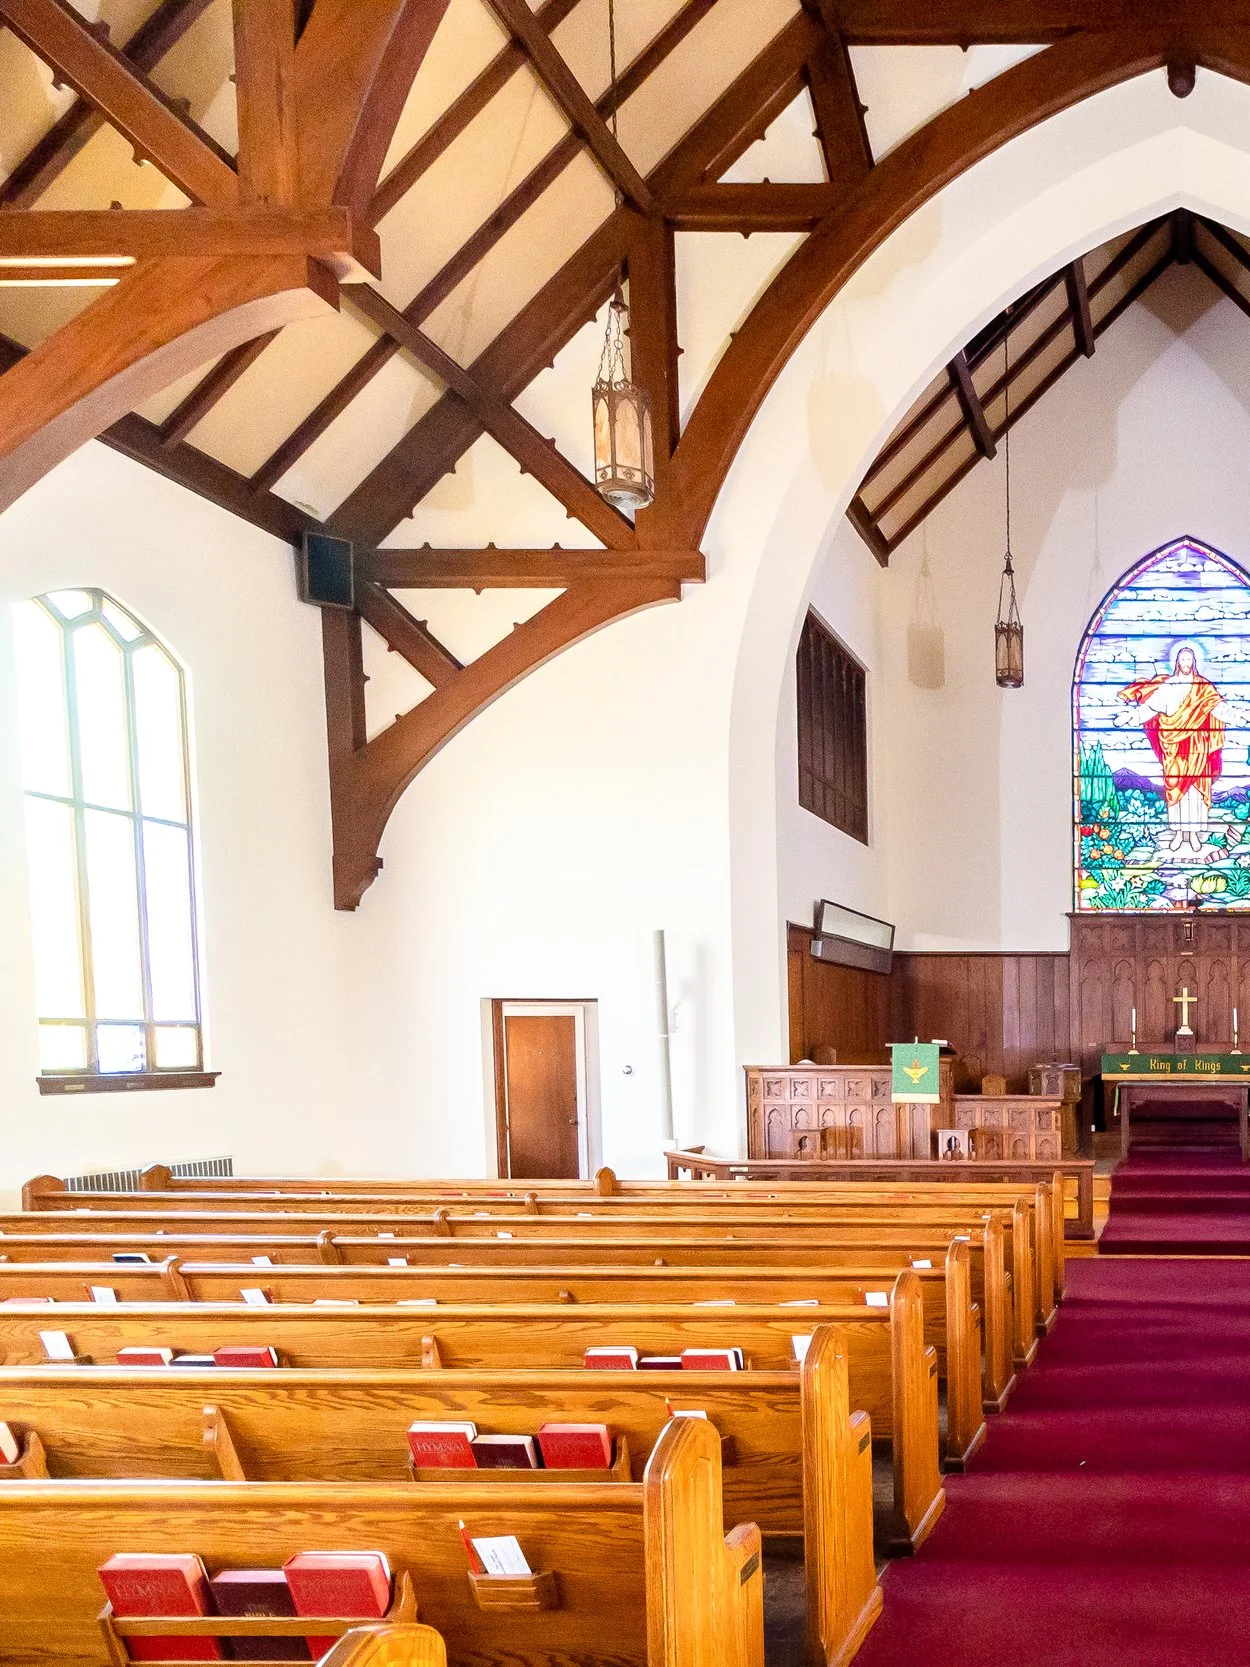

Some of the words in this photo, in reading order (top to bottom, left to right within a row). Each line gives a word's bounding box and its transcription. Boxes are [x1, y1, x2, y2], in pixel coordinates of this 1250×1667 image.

[1149, 1058, 1171, 1074] King
[1177, 1059, 1188, 1070] of
[1194, 1059, 1221, 1074] Kings
[415, 1442, 465, 1452] HYMNAL
